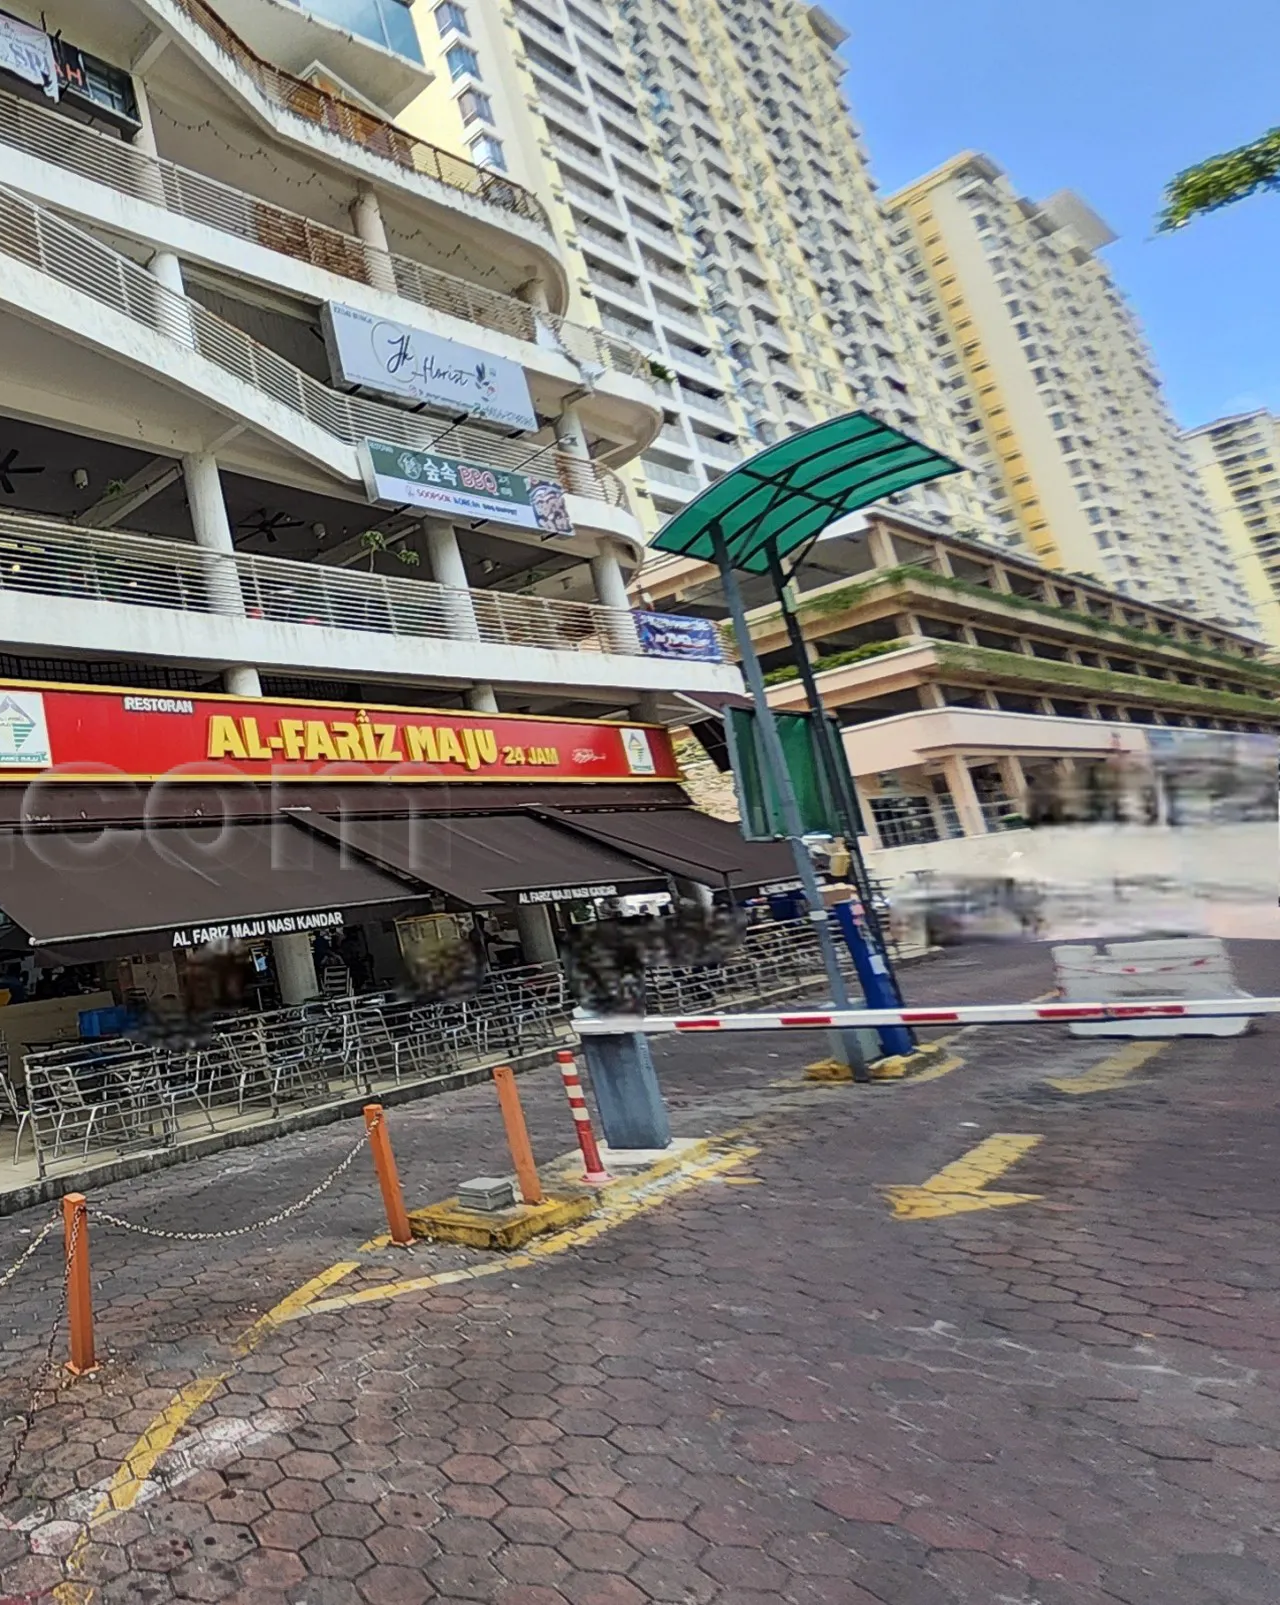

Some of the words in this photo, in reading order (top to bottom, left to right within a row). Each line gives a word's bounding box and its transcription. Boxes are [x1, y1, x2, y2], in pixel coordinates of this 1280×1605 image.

[123, 696, 193, 714] RESTORAN
[404, 724, 498, 771] MAJU
[502, 745, 526, 765] 24
[528, 747, 559, 765] JAM
[519, 893, 530, 904] AL
[172, 931, 192, 948] AL
[192, 926, 230, 945] FARIZ
[231, 921, 266, 939] MAJU
[267, 917, 296, 934] NASI
[296, 911, 344, 930] KANDAR
